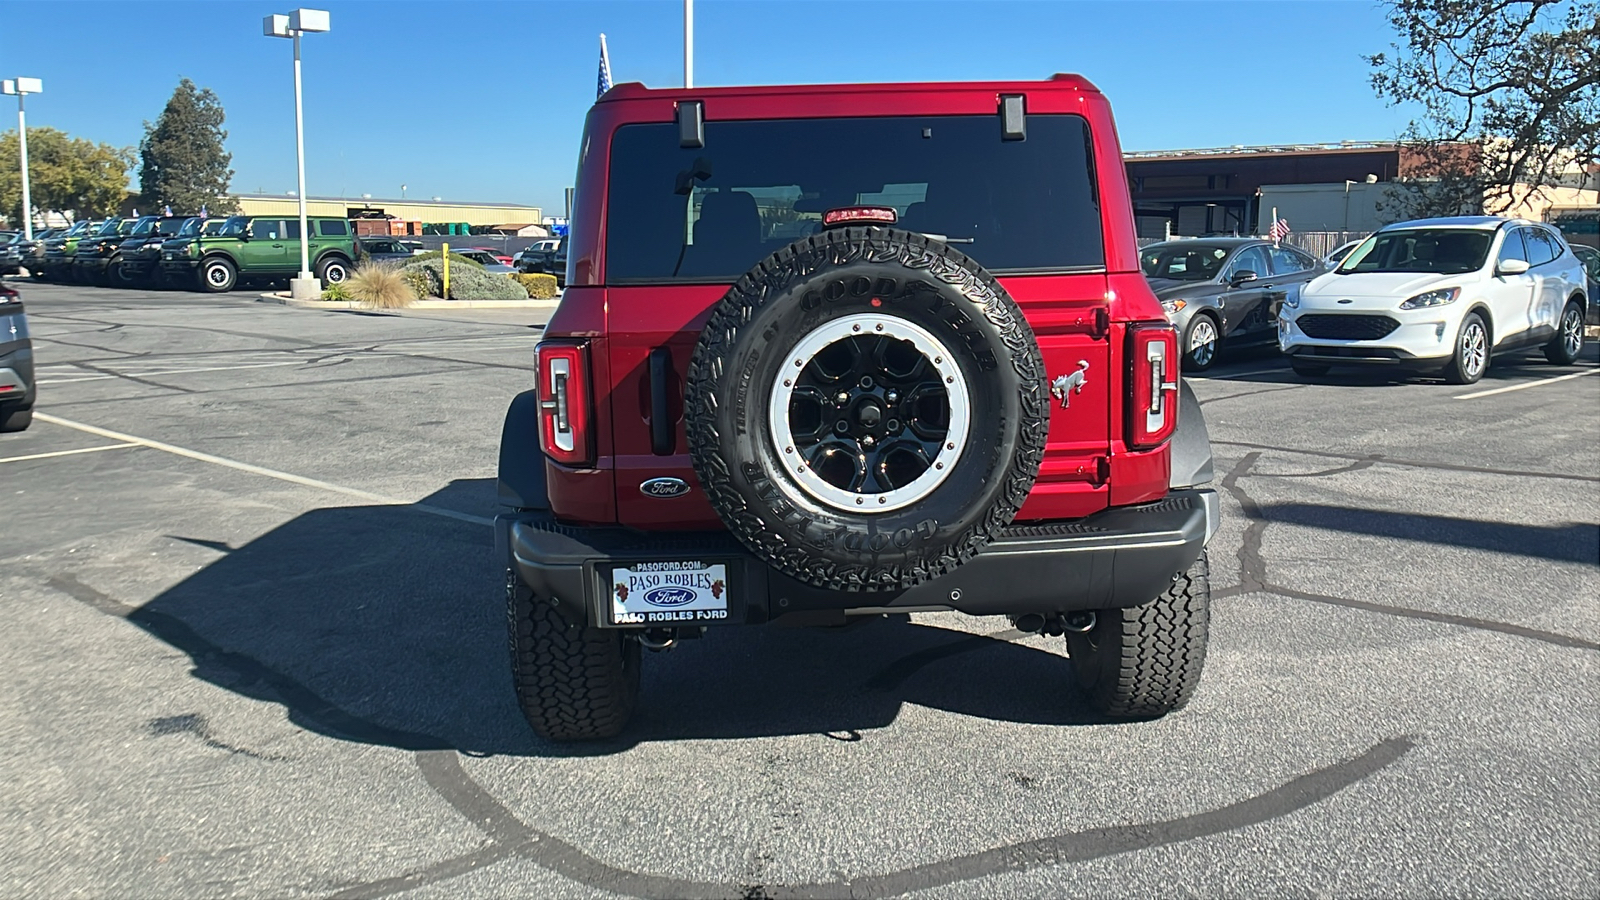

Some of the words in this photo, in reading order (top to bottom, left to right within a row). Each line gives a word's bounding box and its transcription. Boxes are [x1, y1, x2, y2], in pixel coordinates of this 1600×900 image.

[651, 481, 679, 494] Ford
[637, 561, 701, 572] PASOFORD.COM
[629, 574, 660, 592] PASO
[665, 573, 711, 589] ROBLES
[655, 590, 686, 603] Ford
[614, 612, 646, 624] PASO
[649, 611, 694, 622] ROBLES
[697, 610, 728, 620] FORD
